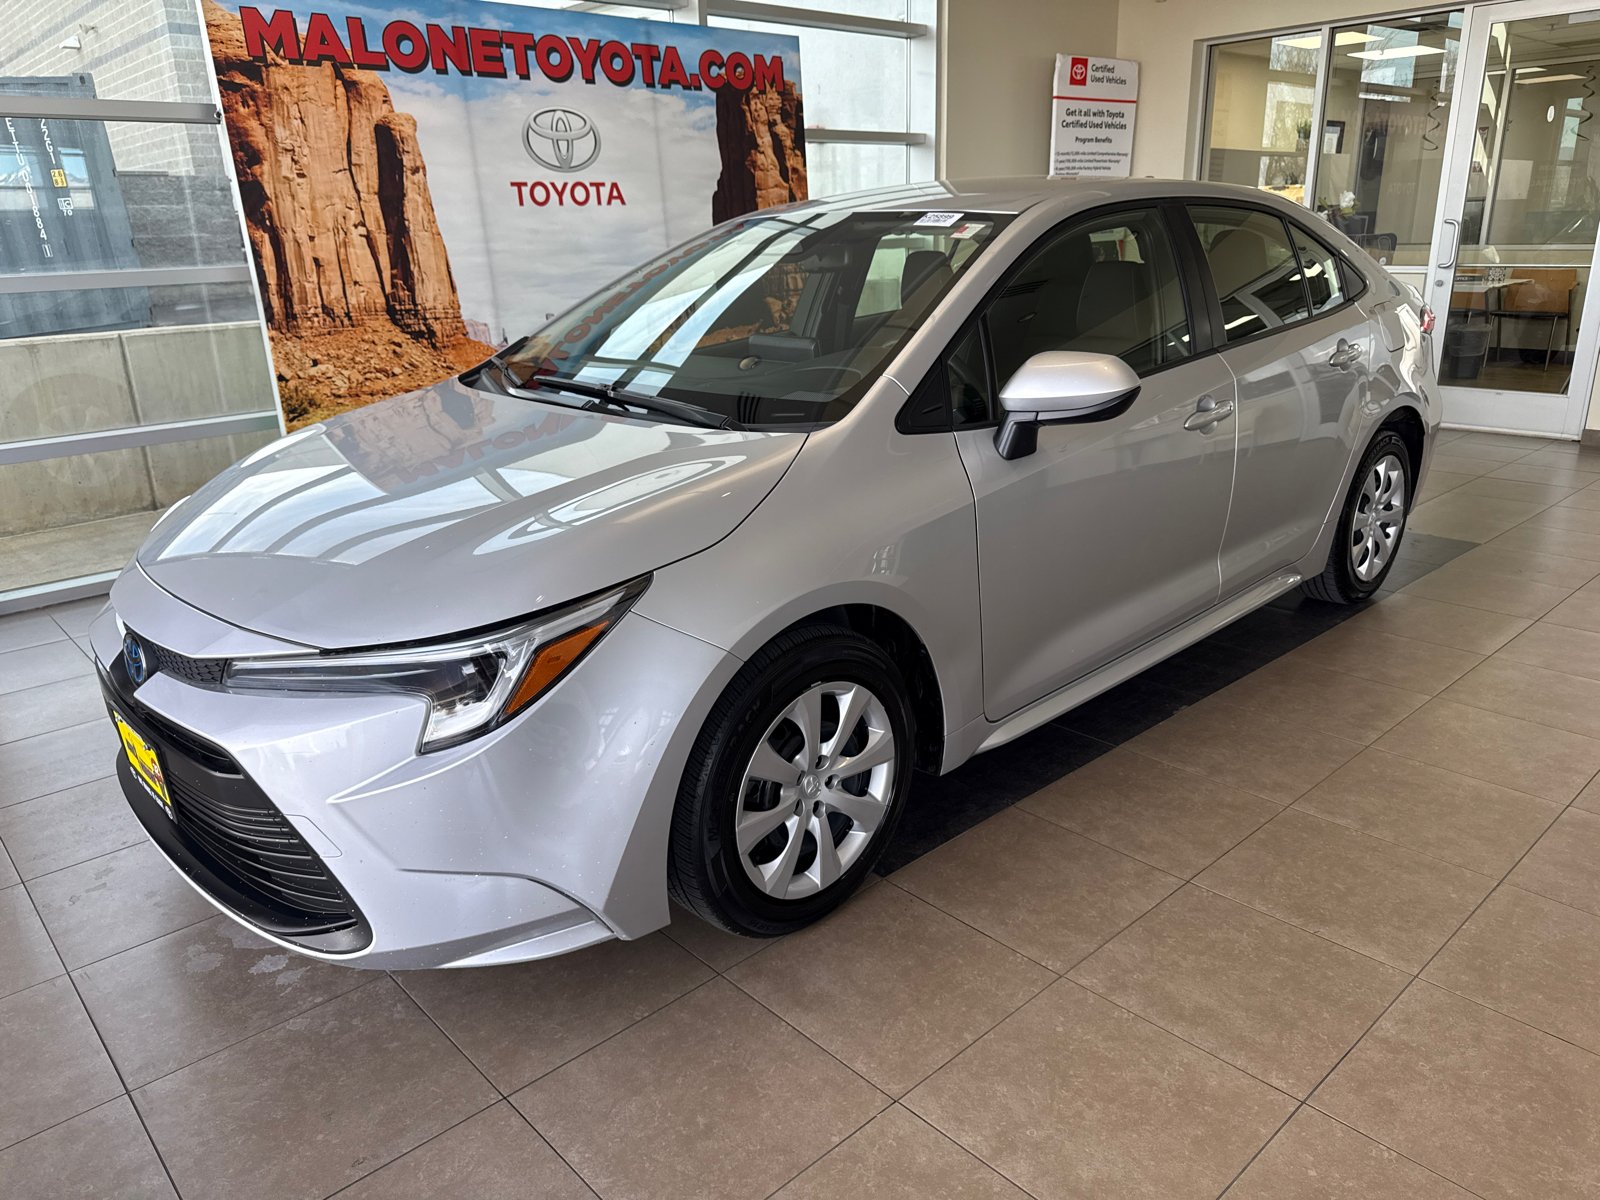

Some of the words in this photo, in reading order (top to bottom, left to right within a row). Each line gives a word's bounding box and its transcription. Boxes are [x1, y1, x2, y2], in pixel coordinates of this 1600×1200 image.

[239, 6, 785, 94] MALONETOYOTA.COM
[1091, 63, 1115, 74] Certified
[1090, 75, 1105, 83] Used
[1105, 76, 1127, 85] Vehicles
[1065, 108, 1077, 117] Get
[1077, 108, 1083, 117] it
[1083, 108, 1092, 117] all
[1092, 109, 1105, 118] with
[1106, 110, 1125, 120] Toyota
[1061, 120, 1088, 129] Certified
[1088, 120, 1103, 129] Used
[1103, 121, 1127, 130] Vehicles
[1075, 136, 1094, 145] Program
[1094, 136, 1113, 144] Benefits
[510, 181, 627, 207] TOYOTA
